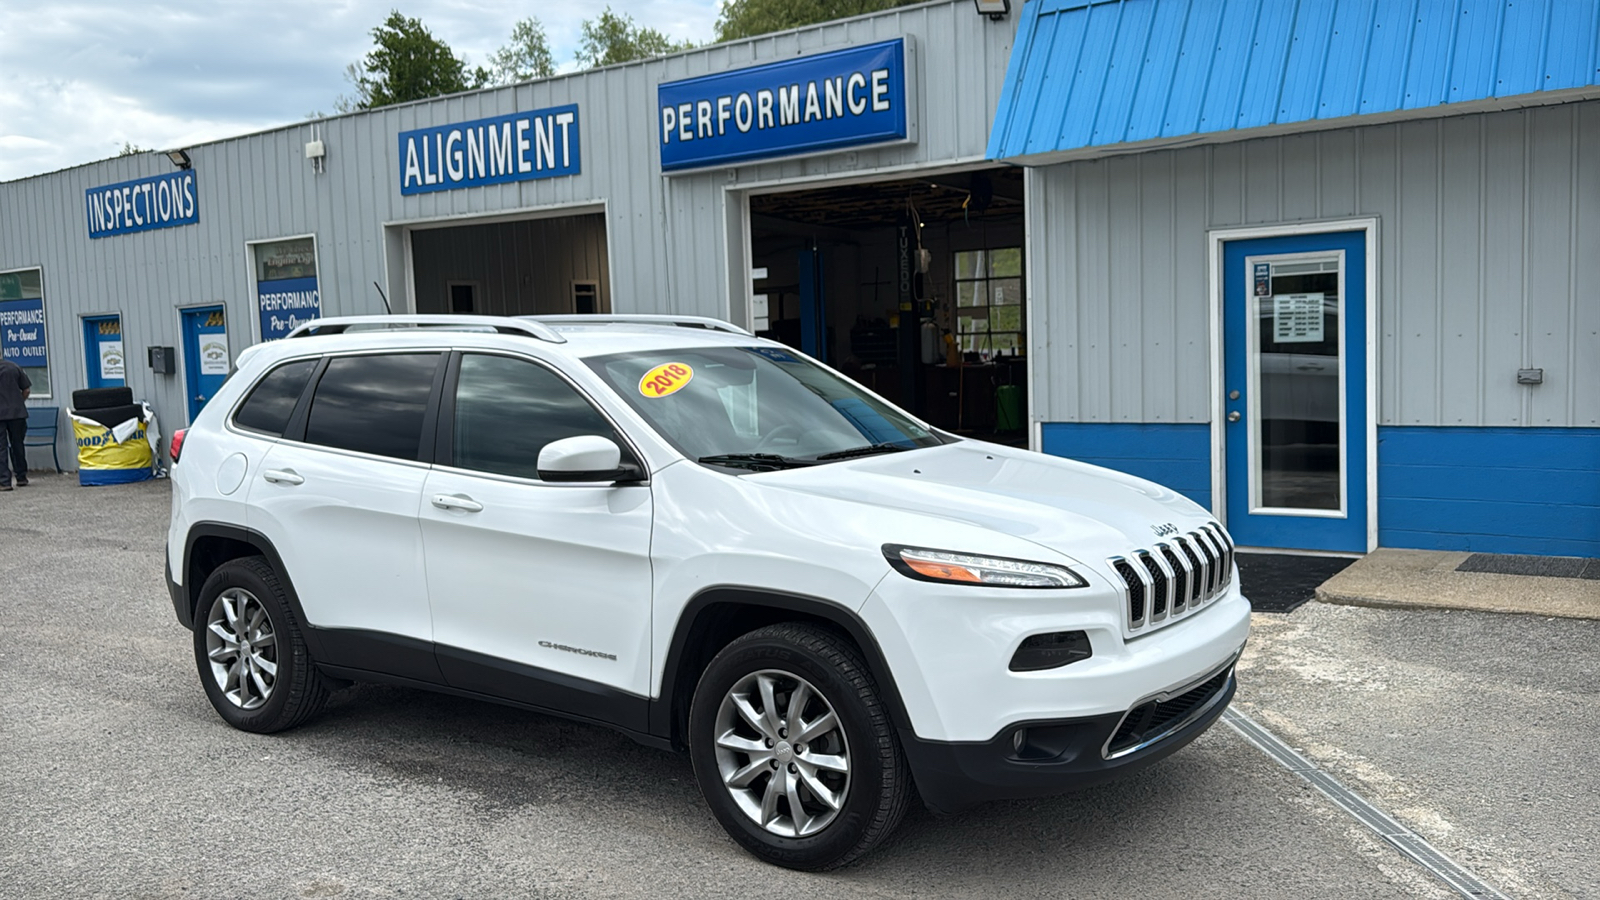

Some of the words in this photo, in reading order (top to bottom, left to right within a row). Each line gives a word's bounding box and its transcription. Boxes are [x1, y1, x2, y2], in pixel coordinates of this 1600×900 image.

[662, 69, 890, 144] PERFORMANCE
[404, 112, 574, 188] ALIGNMENT
[88, 175, 194, 233] INSPECTIONS
[899, 226, 910, 292] TUXEDO
[260, 290, 319, 311] PERFORMANC
[0, 309, 43, 326] PERFORMANCE
[8, 328, 37, 342] Pre-Owned
[4, 347, 20, 357] AUTO
[23, 346, 45, 357] OUTLET
[646, 364, 687, 395] 2018
[1150, 523, 1179, 537] Jeep
[538, 640, 617, 661] CHEROKEE
